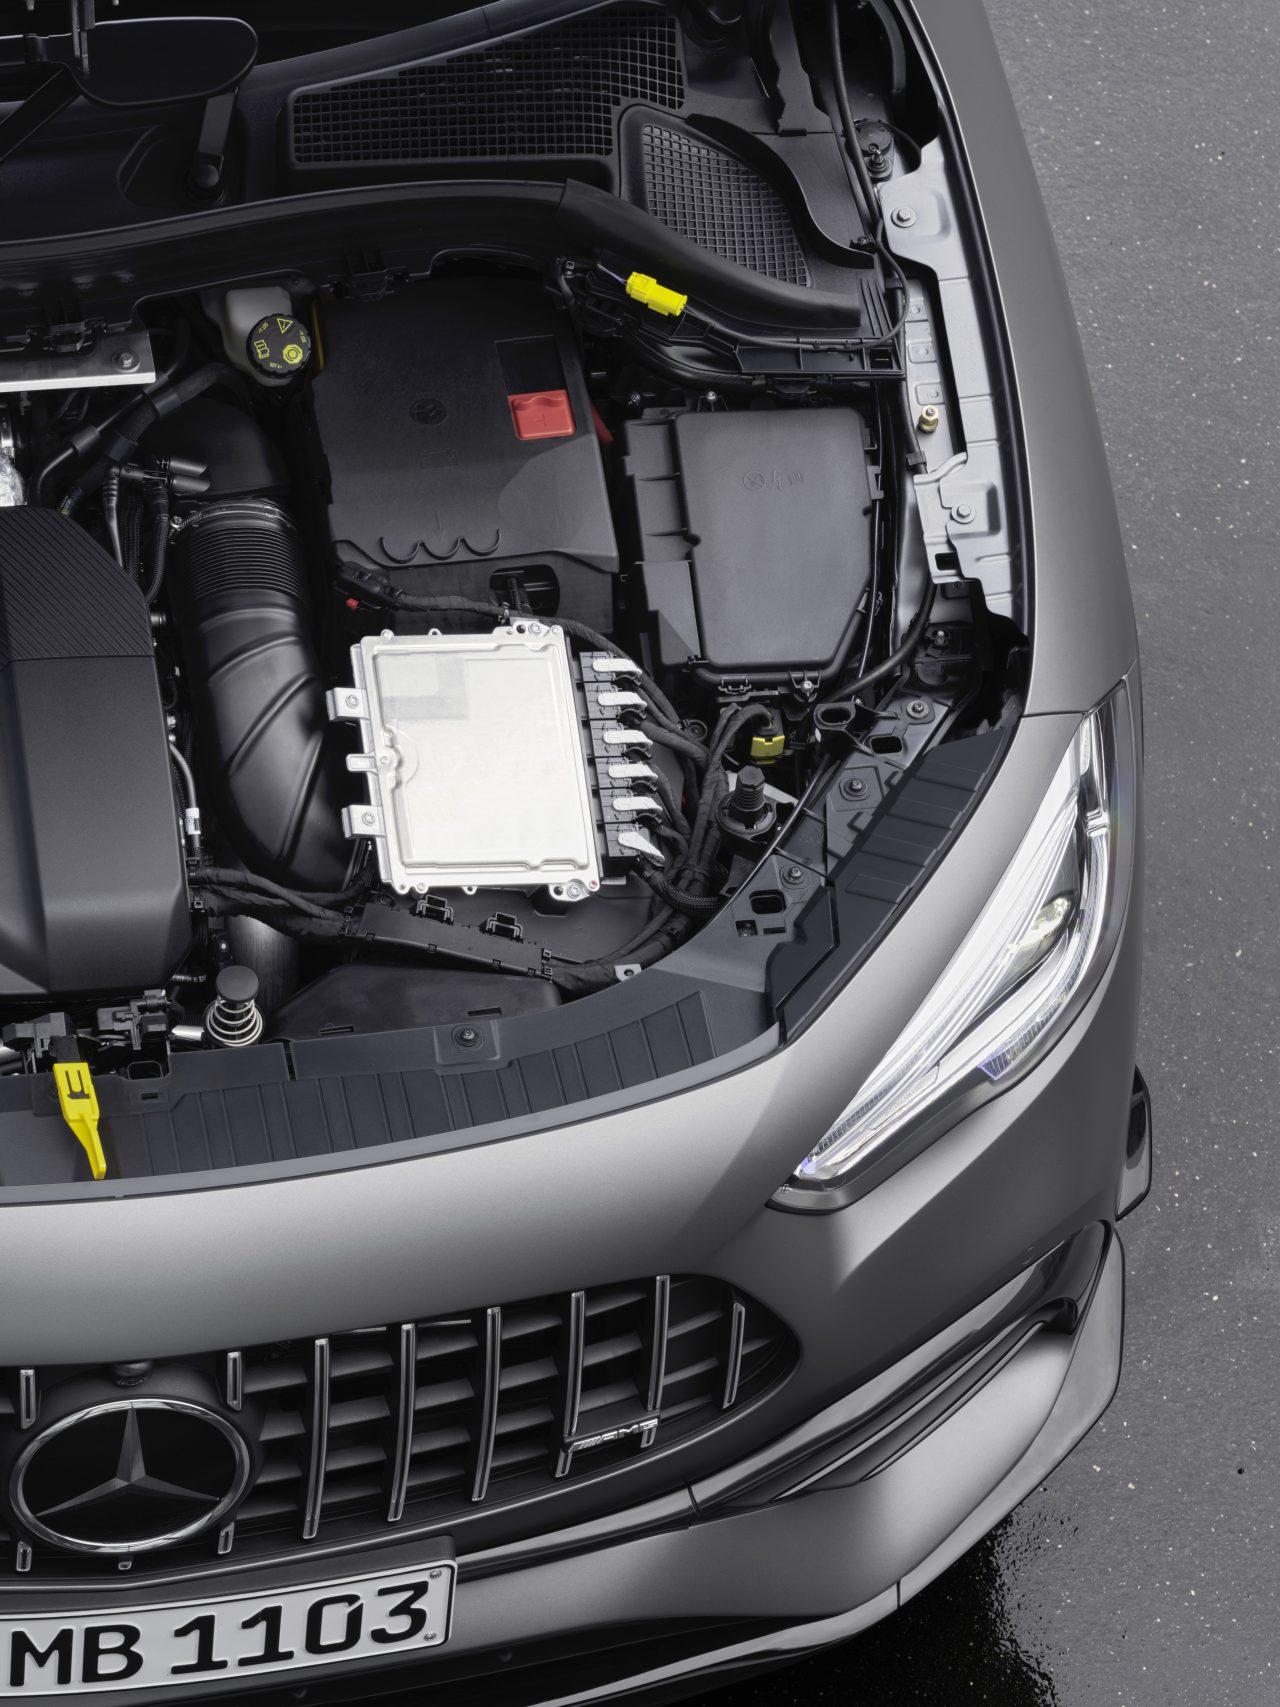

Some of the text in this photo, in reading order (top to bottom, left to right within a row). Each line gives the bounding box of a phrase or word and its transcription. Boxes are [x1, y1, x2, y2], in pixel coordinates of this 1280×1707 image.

[601, 1418, 659, 1441] AMG
[9, 1623, 144, 1687] MB
[170, 1580, 430, 1675] 1103
